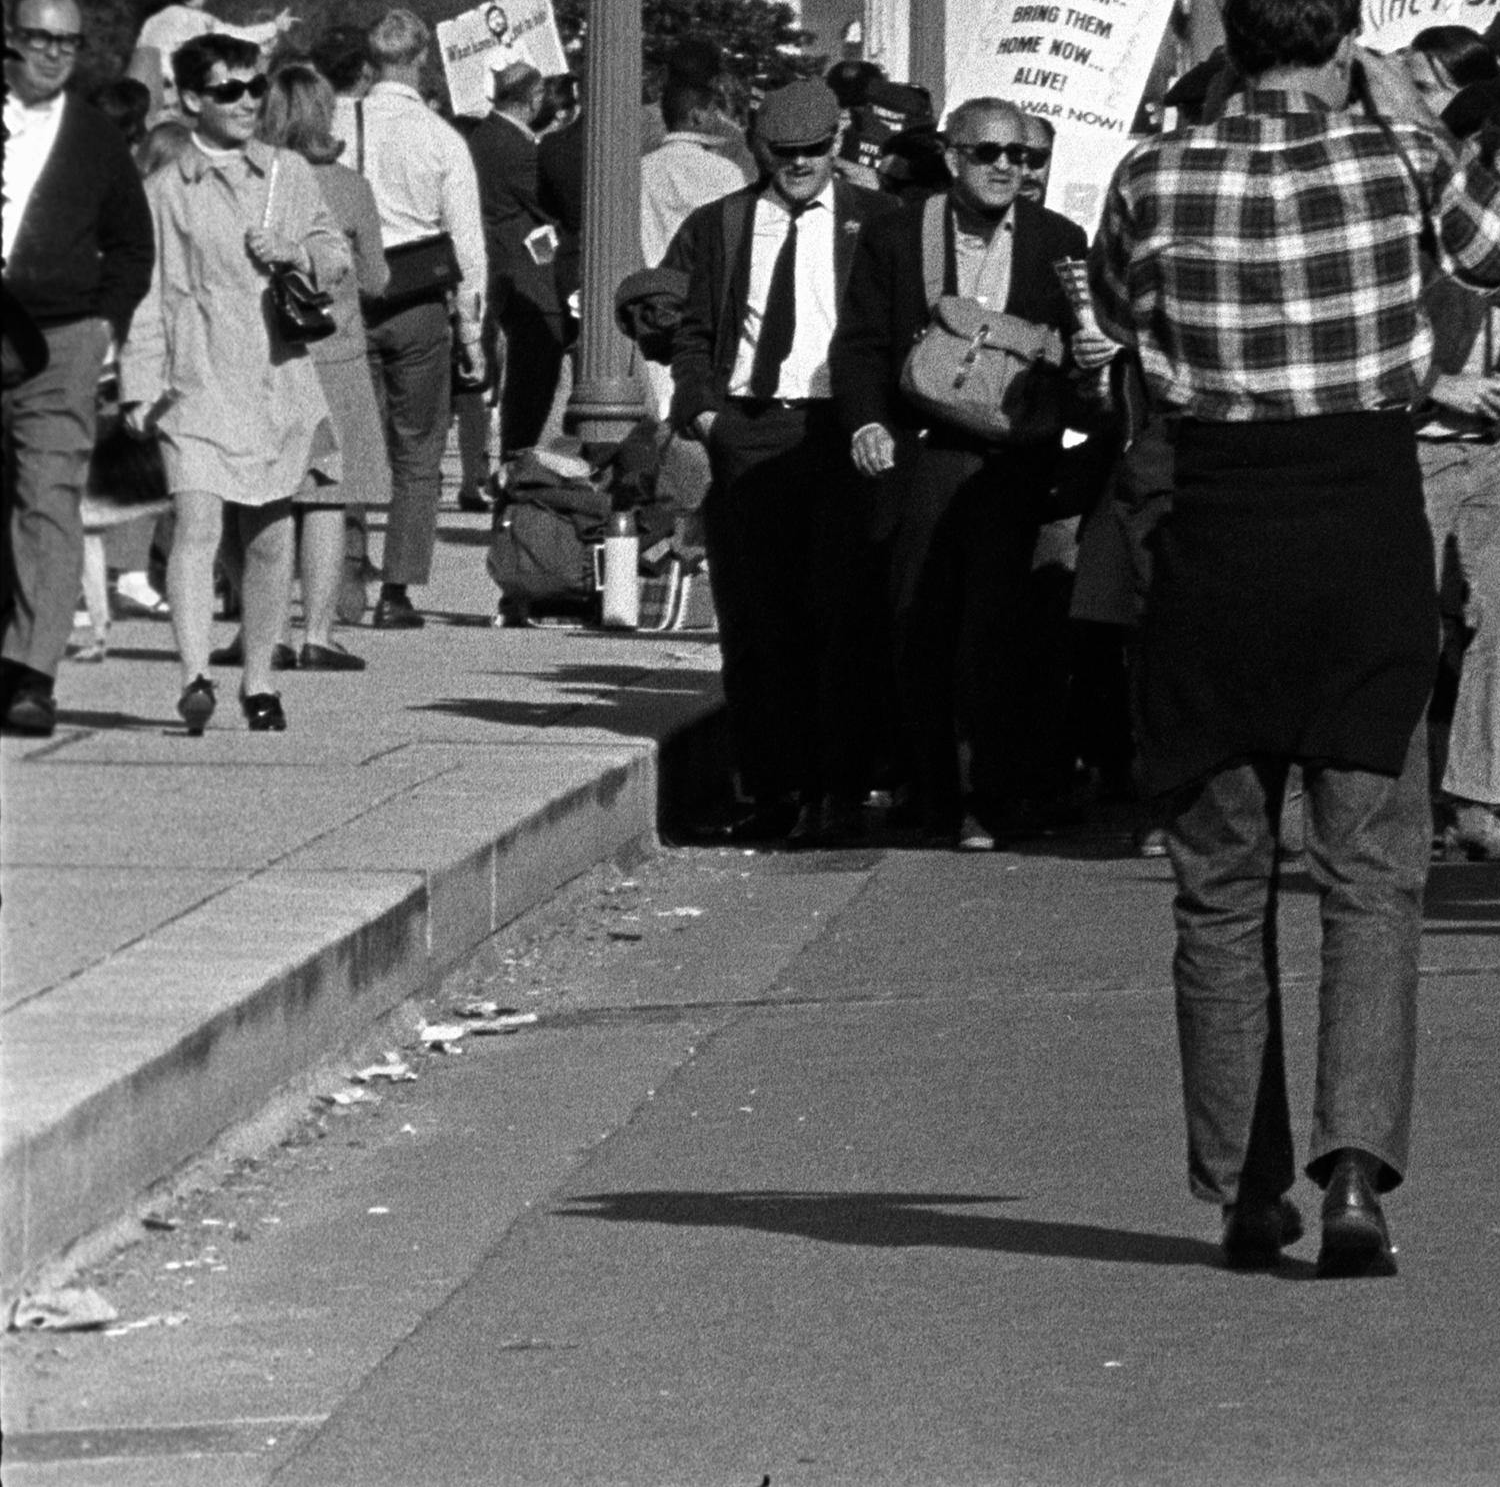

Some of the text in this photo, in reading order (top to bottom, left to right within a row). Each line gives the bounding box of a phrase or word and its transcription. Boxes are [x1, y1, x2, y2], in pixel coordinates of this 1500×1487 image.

[1011, 4, 1114, 39] BRING THEM
[995, 36, 1045, 56] HOME
[1012, 66, 1069, 92] ALIVE!
[1066, 106, 1126, 133] NOW!
